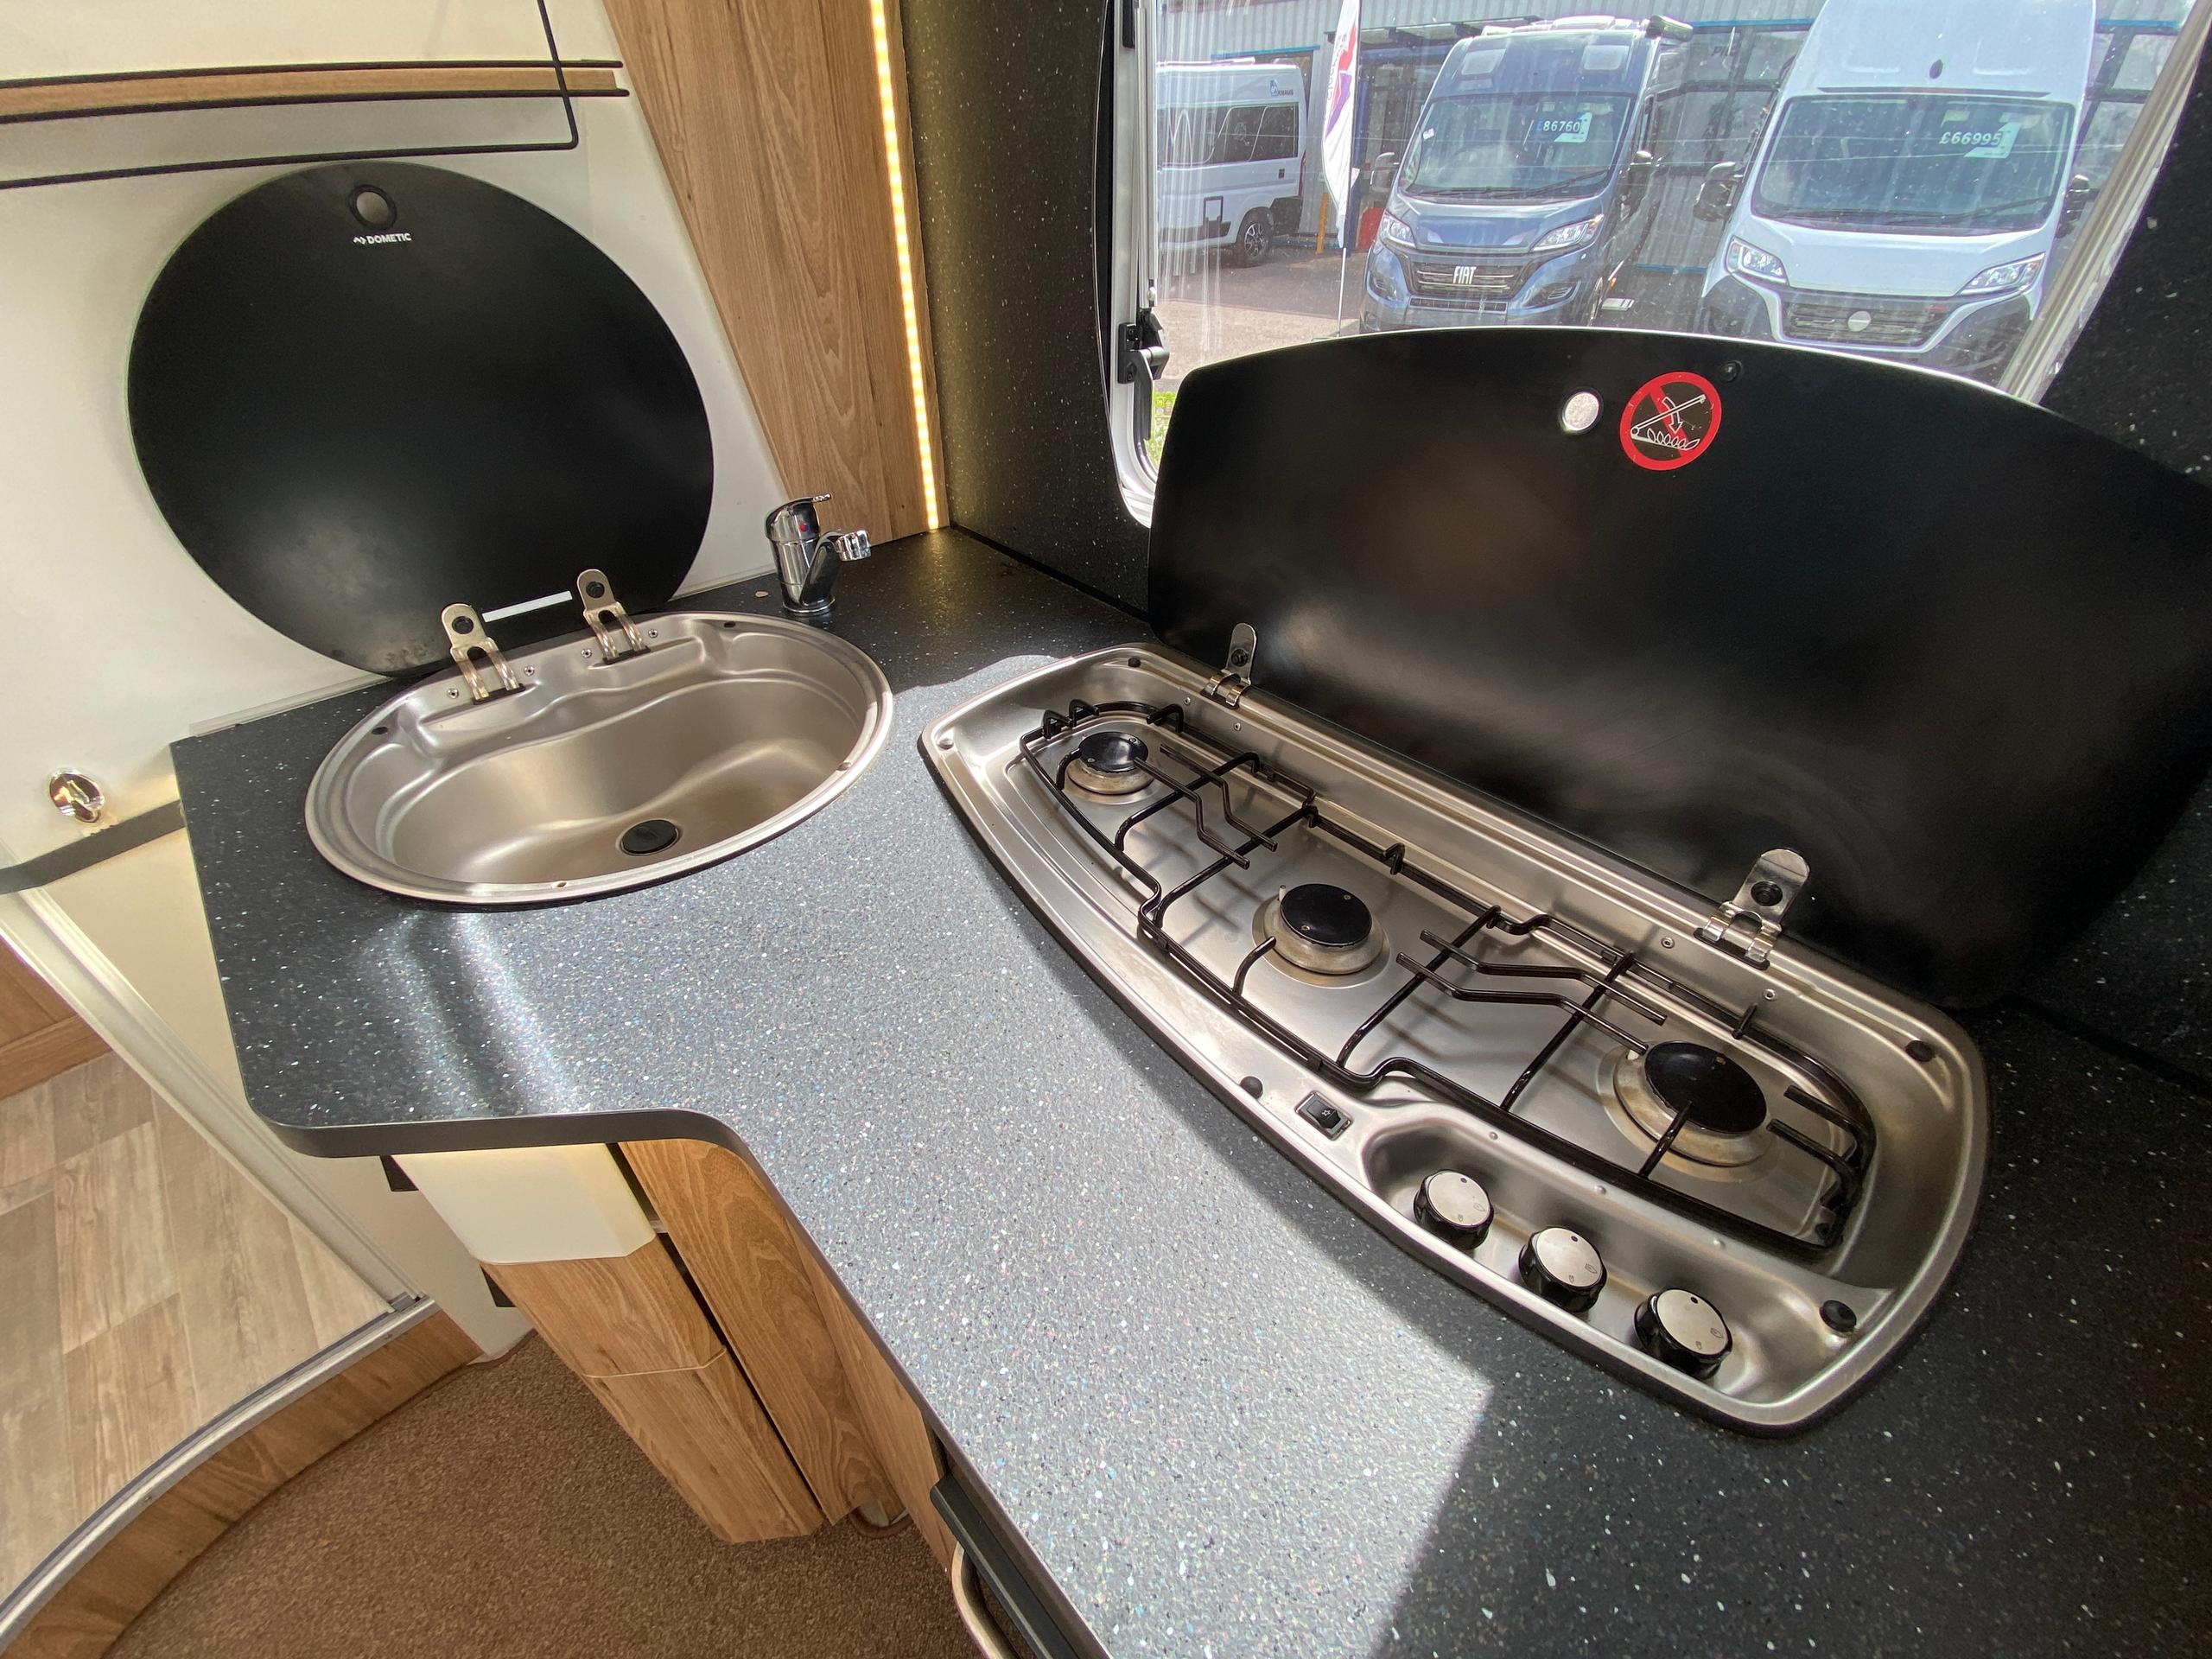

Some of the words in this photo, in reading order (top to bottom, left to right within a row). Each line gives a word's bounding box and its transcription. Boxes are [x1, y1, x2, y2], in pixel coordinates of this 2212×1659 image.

[1939, 131, 2002, 145] £66995
[366, 232, 412, 245] DOMETIC
[1452, 265, 1477, 284] FIAT
